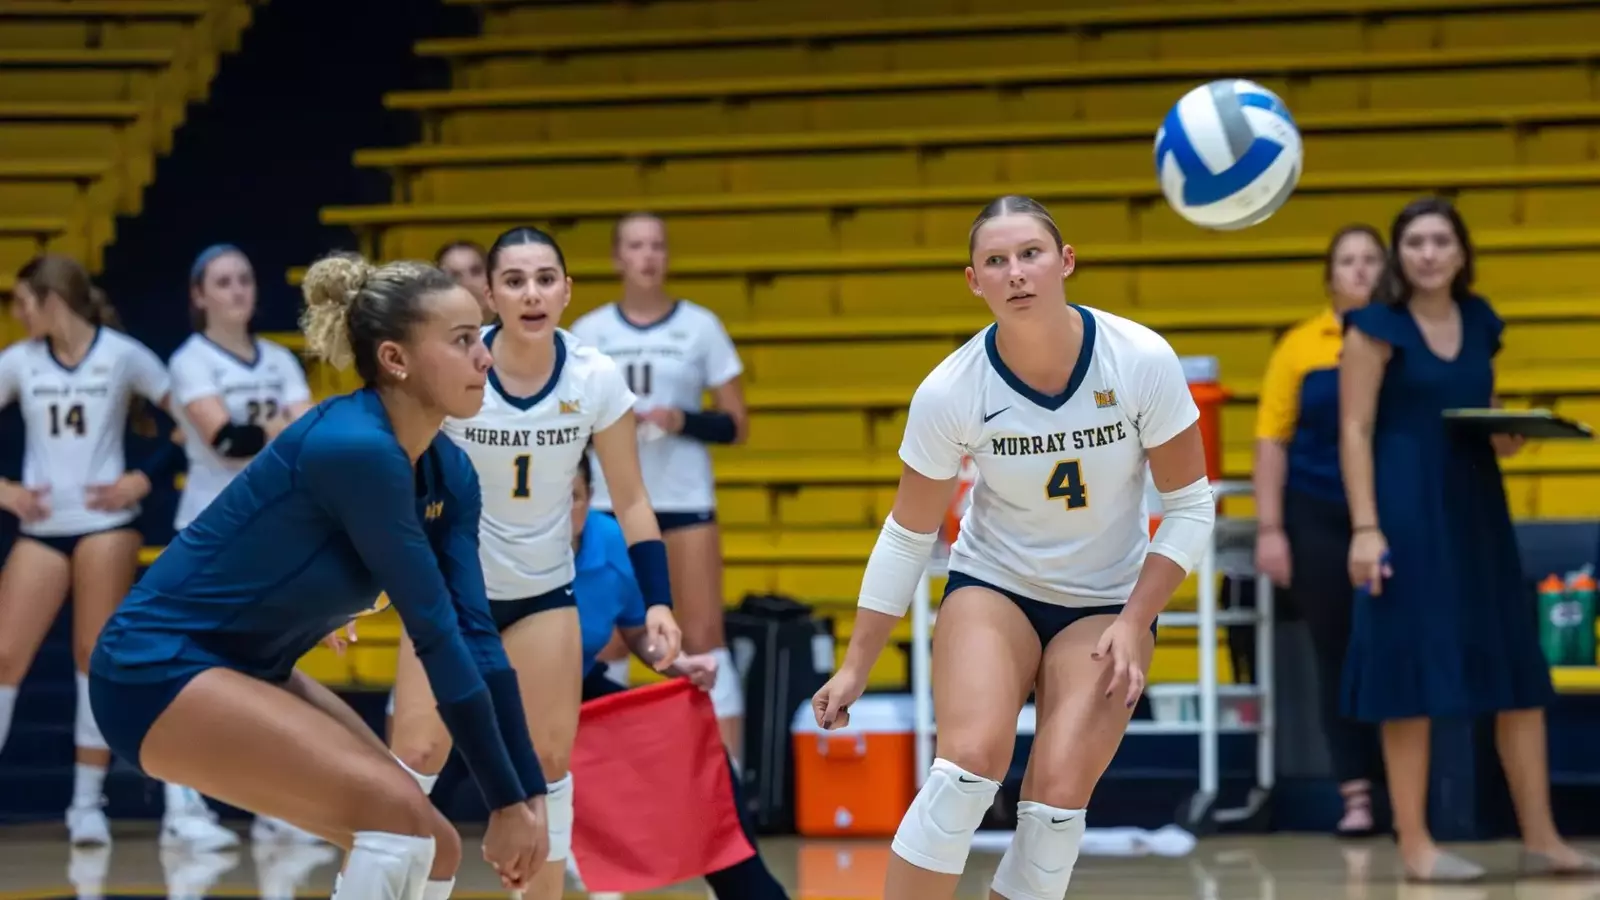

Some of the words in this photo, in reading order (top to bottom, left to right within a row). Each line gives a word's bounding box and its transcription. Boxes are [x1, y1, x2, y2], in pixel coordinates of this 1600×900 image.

[49, 404, 86, 437] 14
[465, 427, 531, 446] MURRAY
[992, 432, 1067, 456] MURRAY
[1072, 421, 1126, 449] STATE
[510, 453, 534, 499] 1
[1044, 458, 1089, 511] 4
